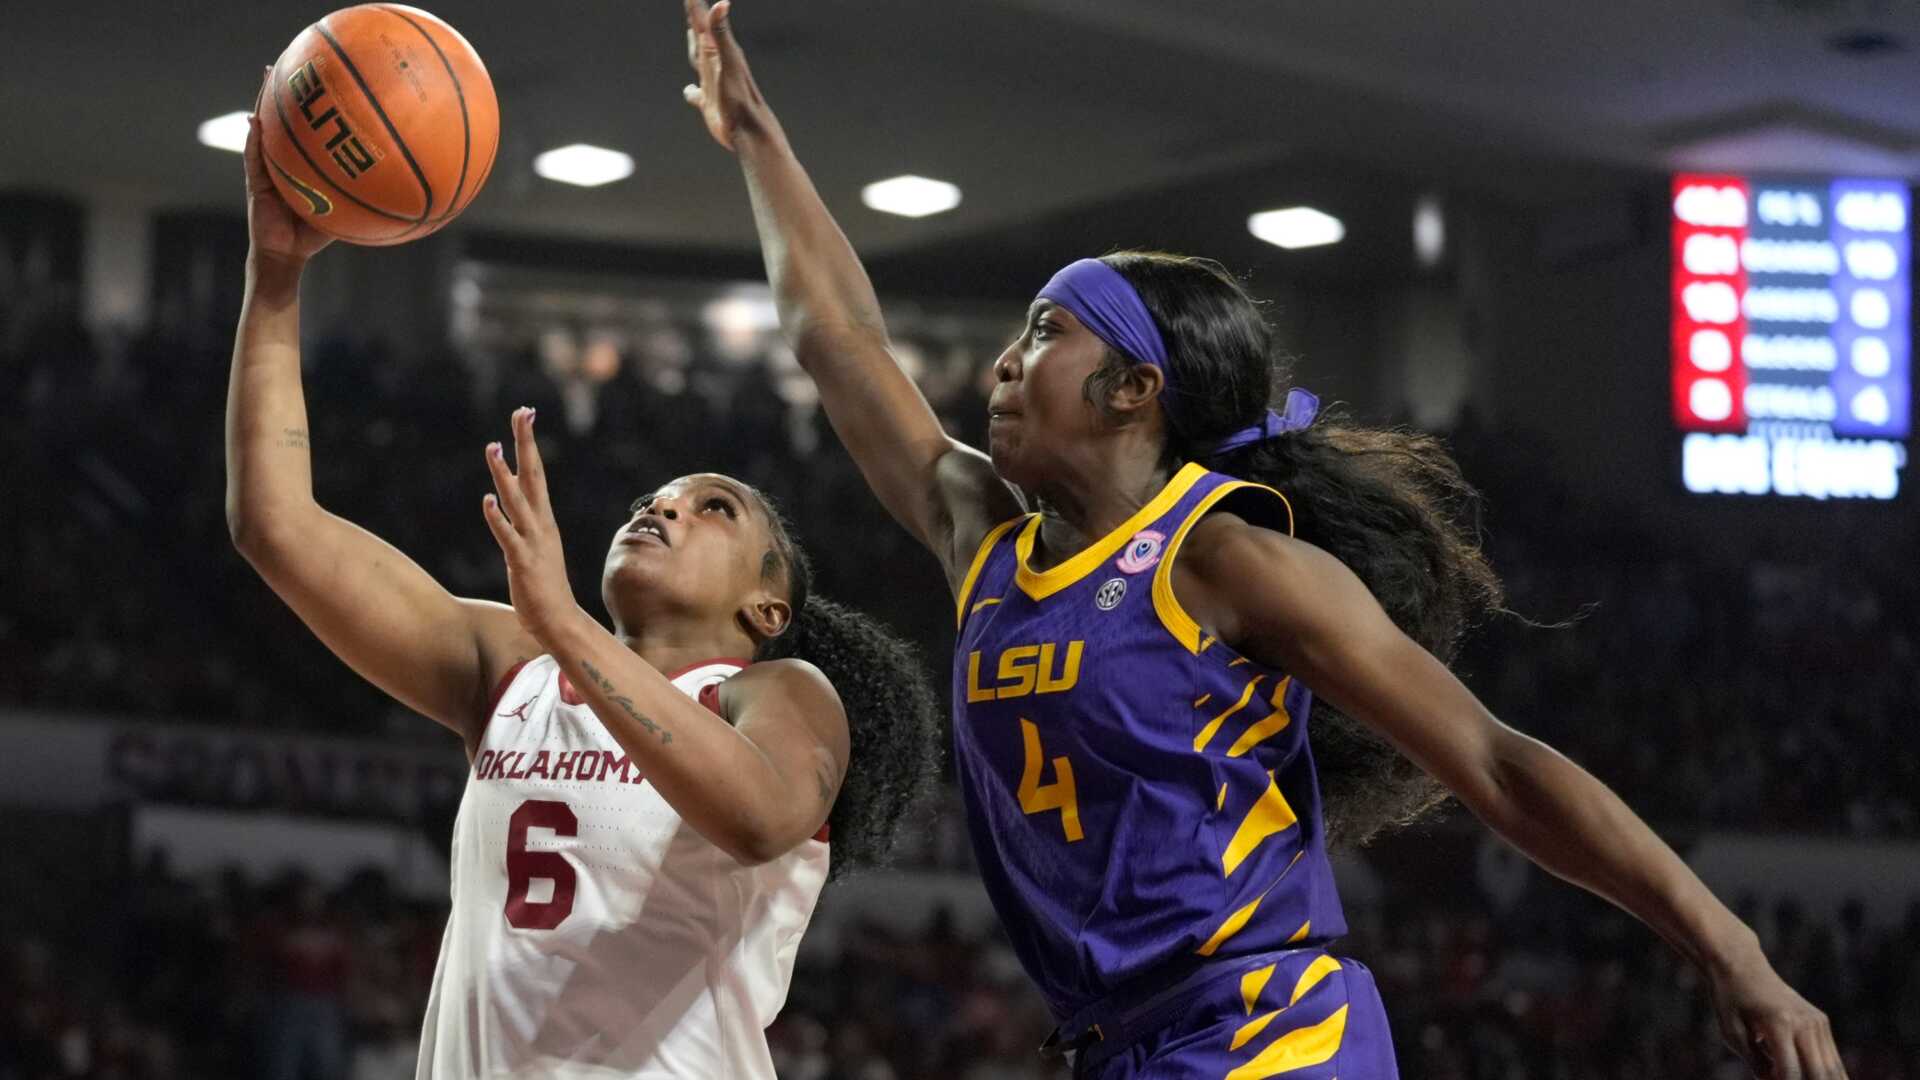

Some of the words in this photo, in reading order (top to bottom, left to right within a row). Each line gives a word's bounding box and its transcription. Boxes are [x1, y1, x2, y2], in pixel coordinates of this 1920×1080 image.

[287, 60, 377, 181] ELITE
[967, 640, 1085, 703] LSU
[1016, 717, 1085, 843] 4
[504, 799, 579, 931] 6
